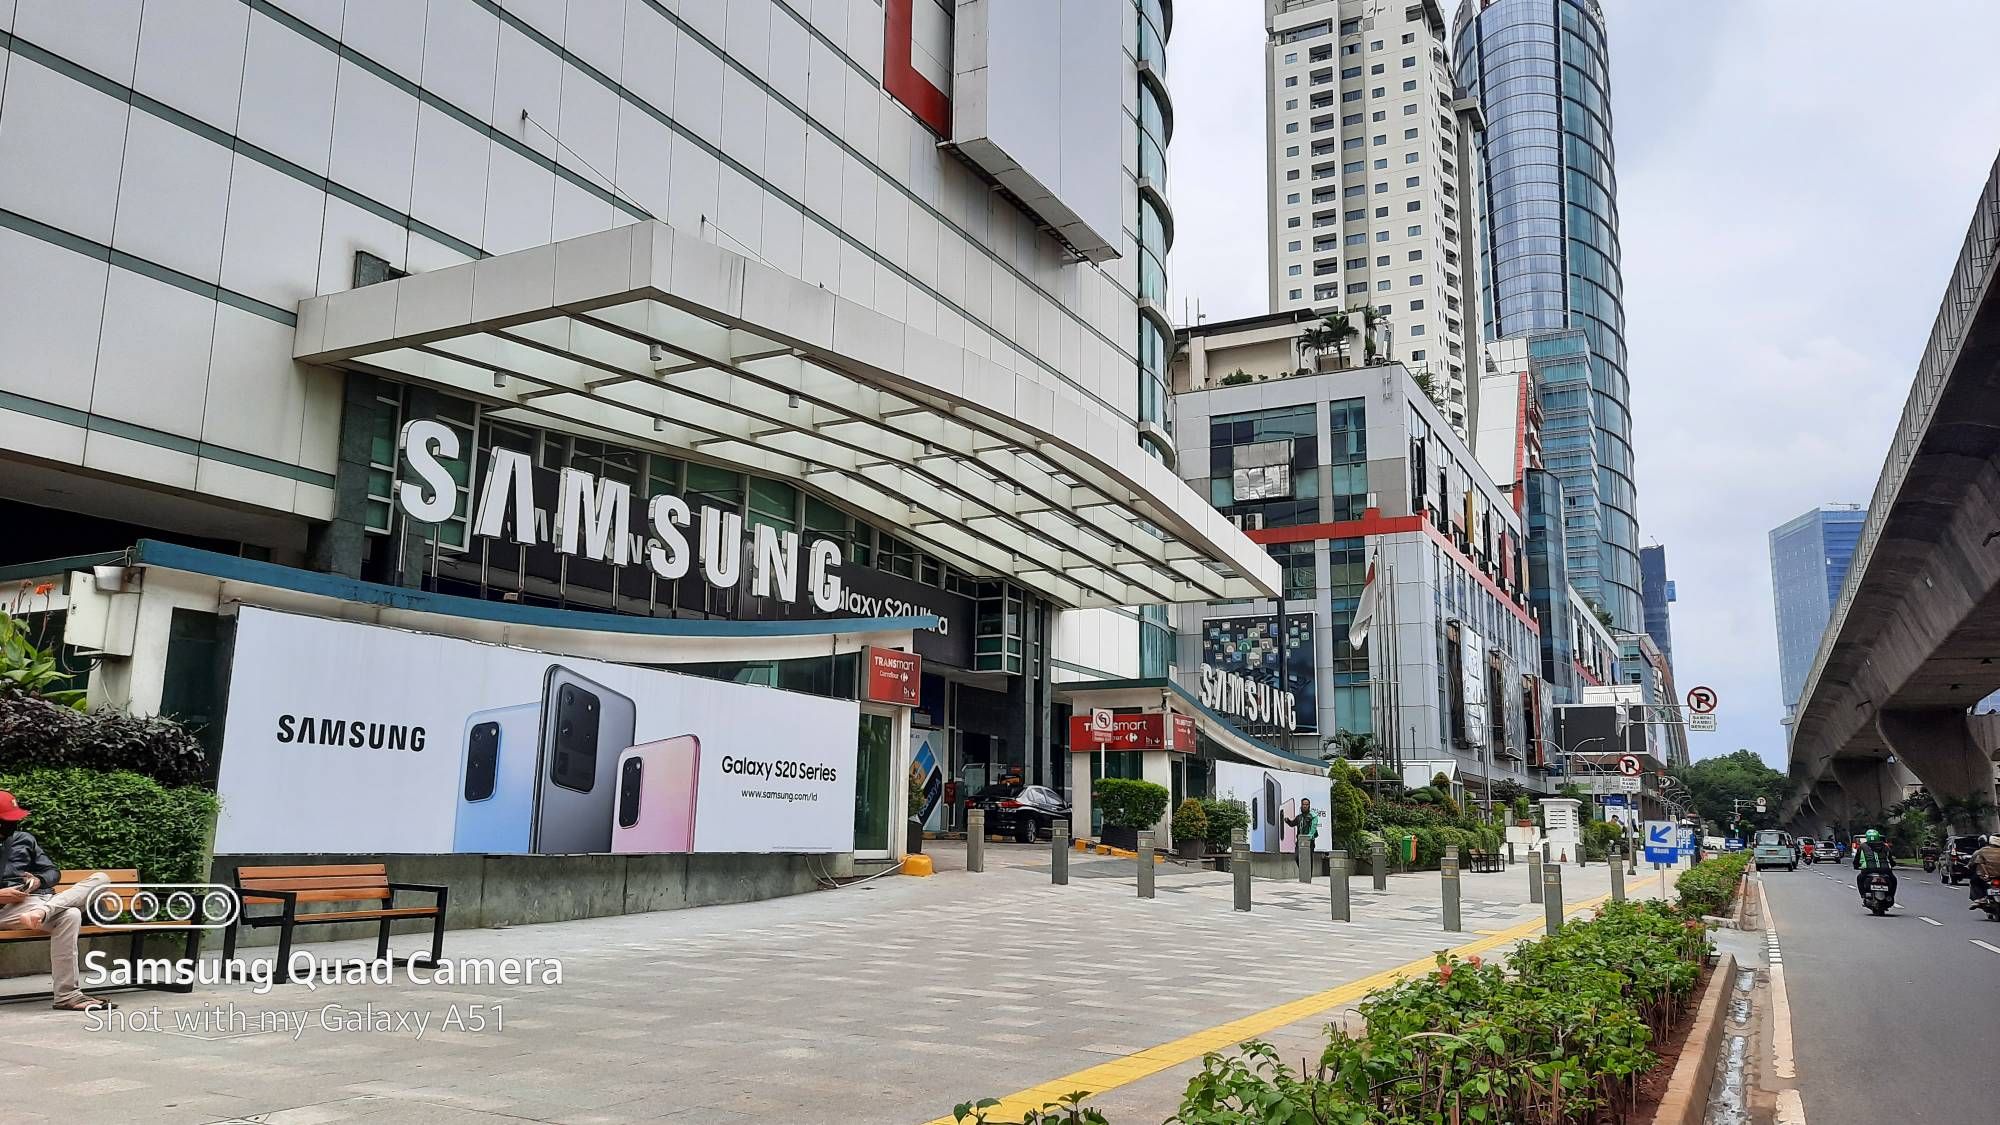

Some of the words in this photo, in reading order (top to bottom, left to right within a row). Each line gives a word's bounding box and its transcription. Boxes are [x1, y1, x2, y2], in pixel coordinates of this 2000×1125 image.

[399, 419, 842, 613] SAMSUNG
[1198, 662, 1297, 731] SAMSUNG
[276, 714, 426, 752] SAMSUNG
[722, 755, 773, 781] Galaxy
[774, 760, 797, 779] S20
[798, 762, 837, 781] Series
[741, 789, 818, 802] www.samsung.com/id
